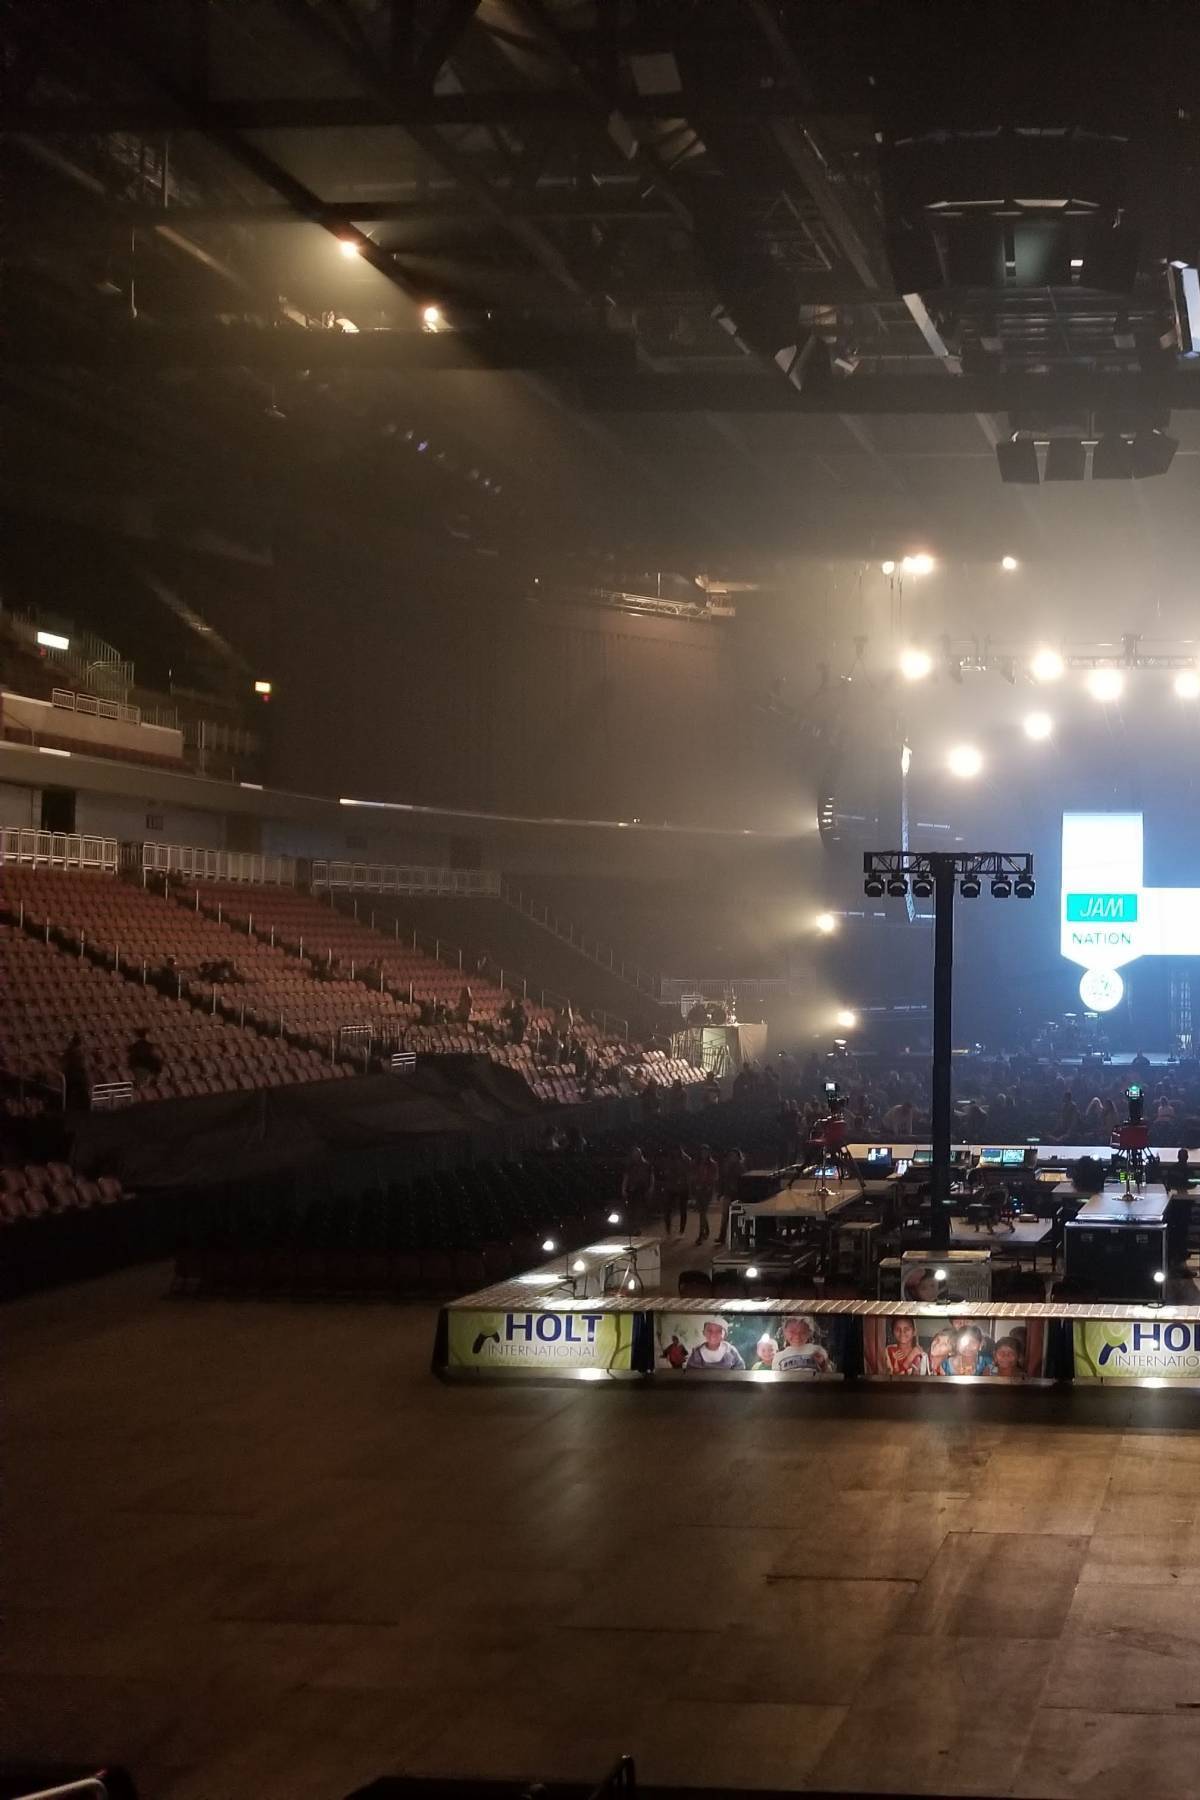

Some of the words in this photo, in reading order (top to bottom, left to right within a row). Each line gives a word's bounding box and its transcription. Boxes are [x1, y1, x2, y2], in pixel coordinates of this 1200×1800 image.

[1079, 898, 1124, 918] JAM
[1072, 932, 1132, 945] NATION
[506, 1313, 603, 1342] HOLT
[488, 1345, 598, 1359] INTERNATIONAL
